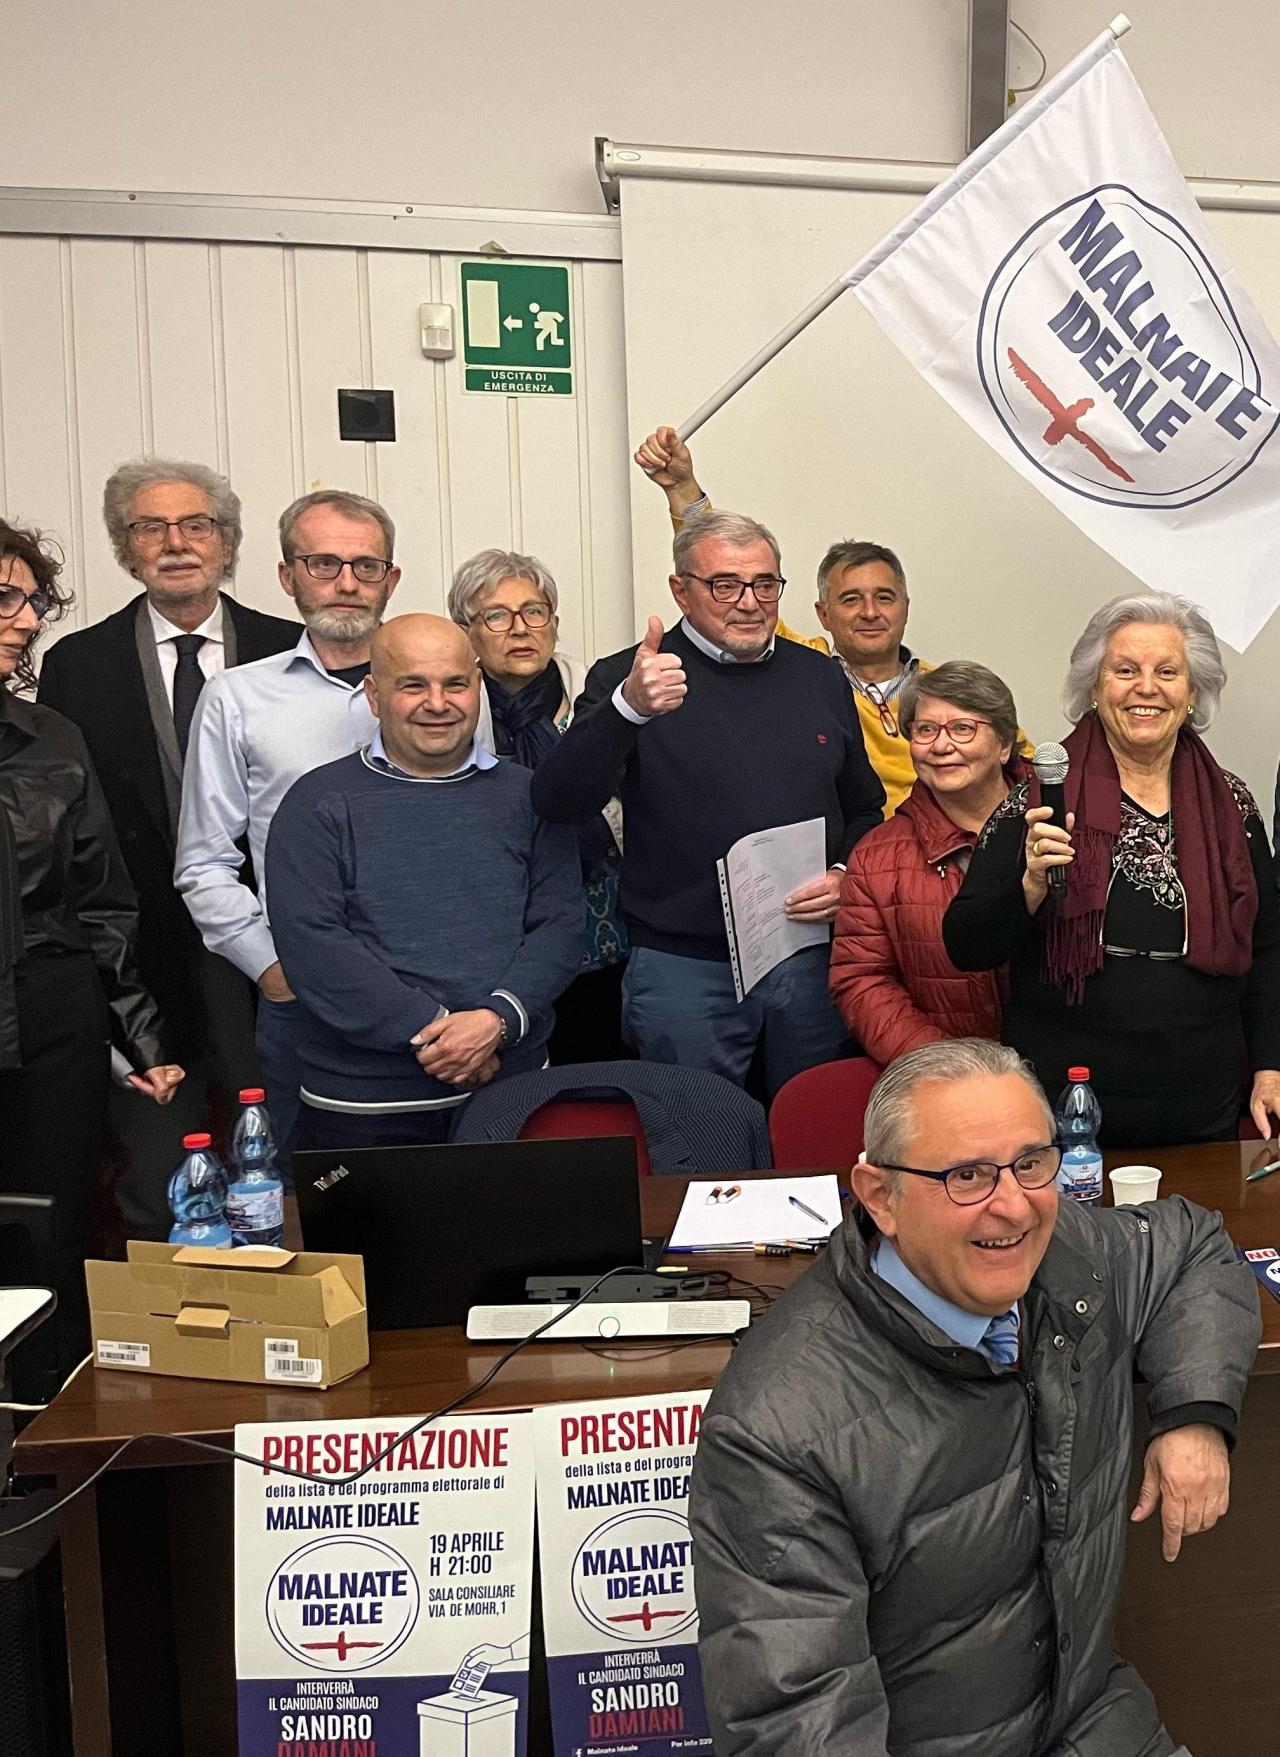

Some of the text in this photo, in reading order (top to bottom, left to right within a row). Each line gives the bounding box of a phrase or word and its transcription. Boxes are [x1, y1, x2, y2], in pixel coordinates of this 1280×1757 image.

[1058, 198, 1262, 441] MALNATE
[491, 371, 547, 381] USCITA DI
[1047, 290, 1192, 453] IDEALE
[484, 382, 554, 392] EMERGENZA
[1247, 1250, 1278, 1260] NO
[262, 1428, 509, 1476] PRESENTAZIONE
[565, 1464, 594, 1478] della
[597, 1462, 622, 1476] lista
[625, 1462, 631, 1473] e
[634, 1457, 652, 1471] del
[266, 1485, 295, 1498] della
[299, 1484, 325, 1497] lista
[338, 1482, 356, 1496] del
[360, 1479, 429, 1497] programma
[432, 1476, 491, 1492] elettorale
[494, 1475, 505, 1489] di
[567, 1479, 650, 1510] MALNATE
[266, 1502, 420, 1531] MALNATE IDEALE
[430, 1531, 505, 1554] 19 APRILE
[430, 1554, 492, 1576] H 21:00
[278, 1569, 408, 1601] MALNATE
[428, 1584, 516, 1602] SALA CONSILIARE
[606, 1571, 684, 1600] IDEALE
[302, 1602, 383, 1626] IDEALE
[428, 1601, 506, 1618] VIA DE MOHR, 1
[604, 1648, 661, 1668] INTERVERRÀ
[578, 1663, 684, 1685] IL CANDIDATO SINDACO
[296, 1679, 355, 1695] INTERVERRÀ
[591, 1681, 679, 1714] SANDRO
[268, 1696, 379, 1711] IL CANDIDATO SINDACO
[281, 1714, 372, 1741] SANDRO
[589, 1707, 685, 1739] DAMIANI
[277, 1741, 376, 1757] DAMIANI
